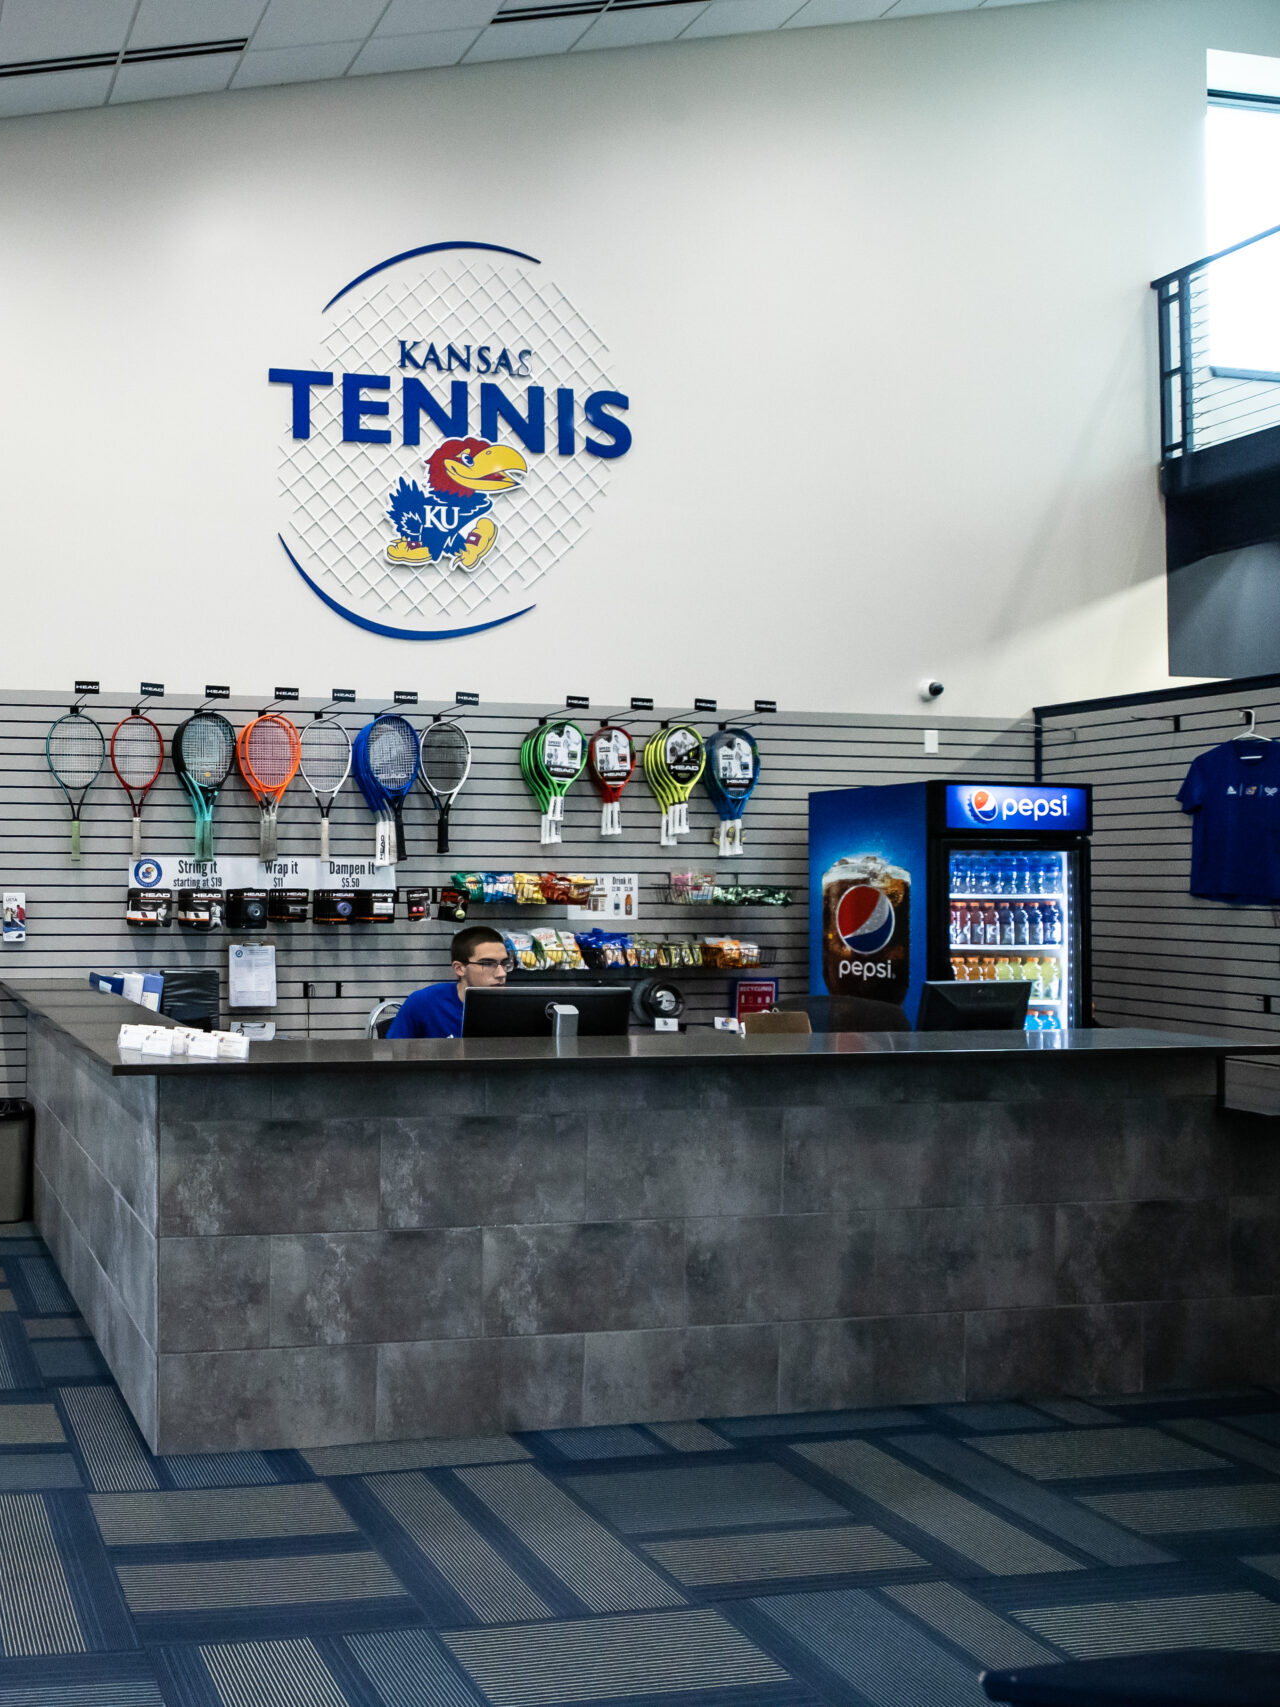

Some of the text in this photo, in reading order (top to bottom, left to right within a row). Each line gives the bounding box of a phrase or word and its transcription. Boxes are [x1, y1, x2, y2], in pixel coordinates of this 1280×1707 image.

[398, 340, 532, 376] KANSAS
[269, 367, 632, 458] TENNIS
[423, 505, 459, 530] KU
[1002, 794, 1068, 821] pepsi
[178, 860, 207, 877] String
[210, 860, 218, 874] it
[265, 861, 289, 877] Wrap
[291, 861, 298, 874] it
[329, 861, 365, 877] Dampen
[173, 877, 222, 889] starting at $19
[273, 877, 283, 888] $11
[341, 877, 360, 888] $5.50
[838, 960, 892, 981] pepsi
